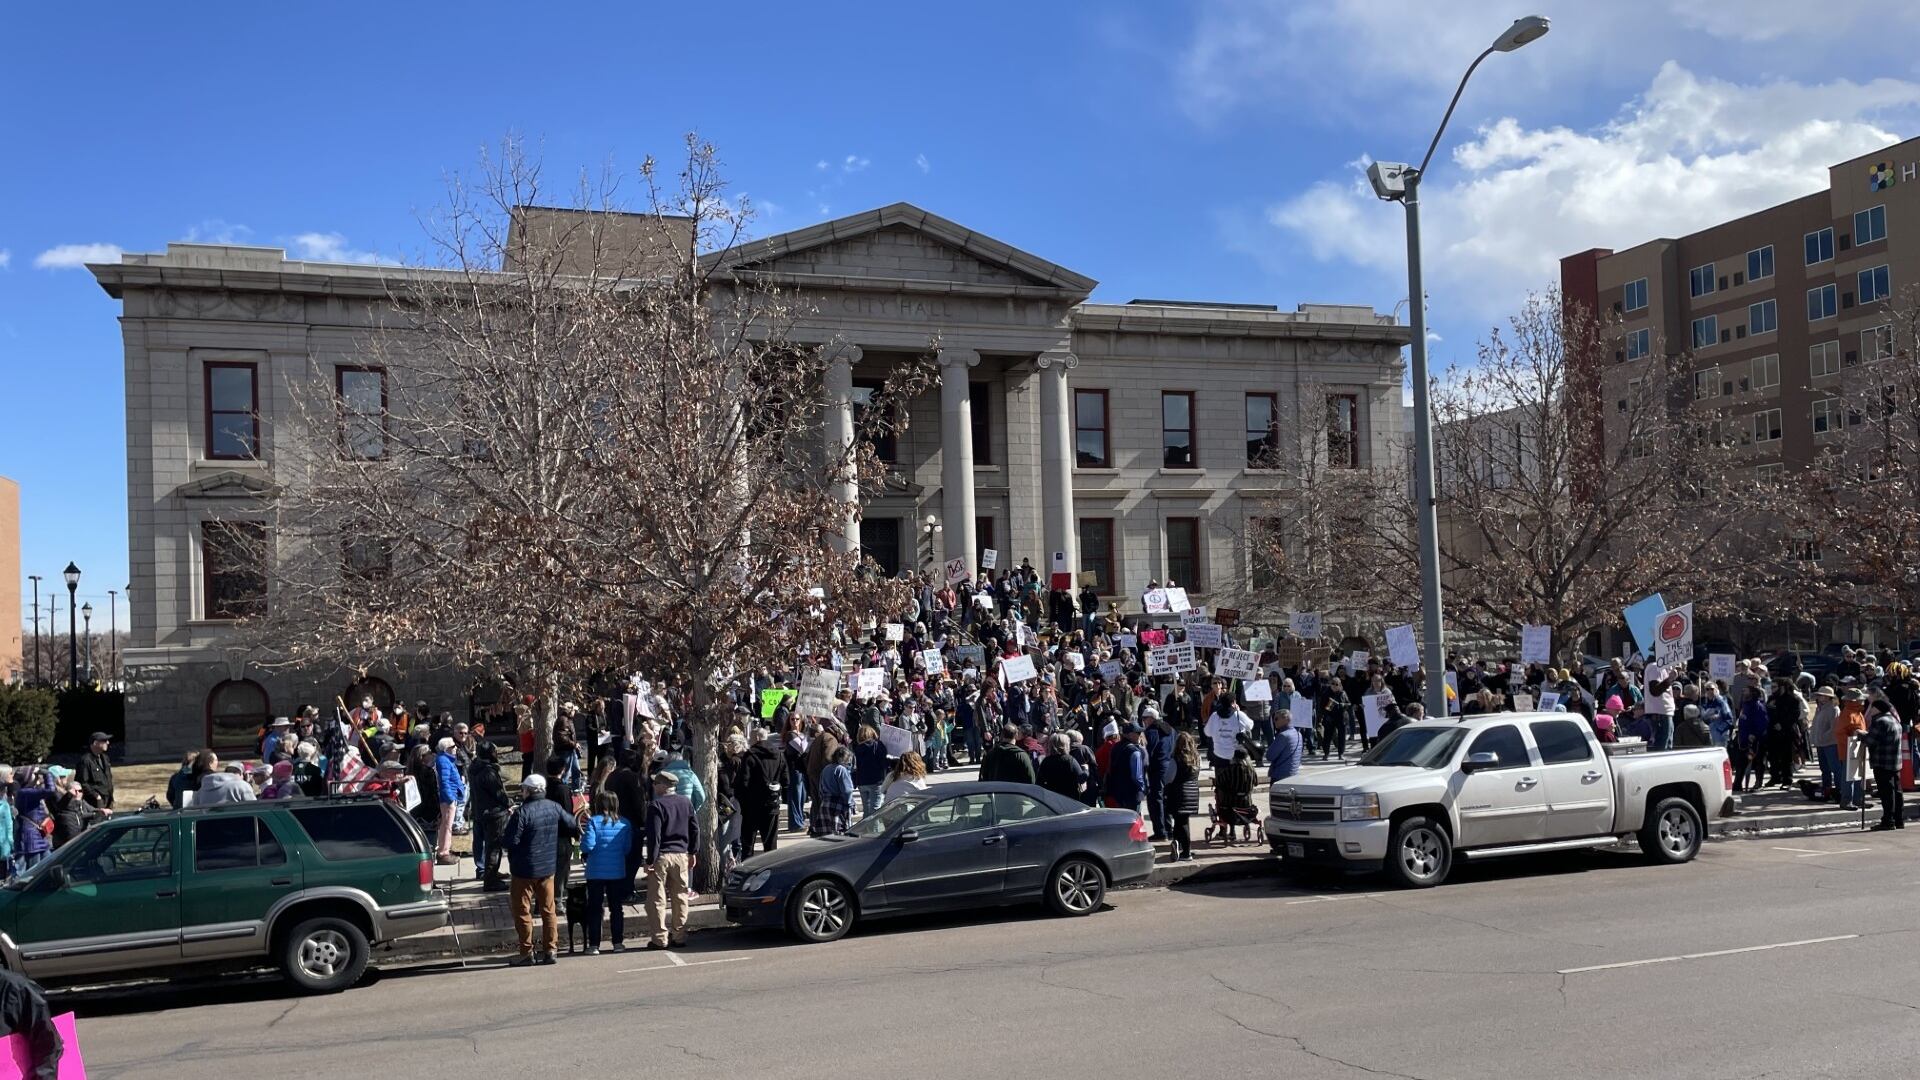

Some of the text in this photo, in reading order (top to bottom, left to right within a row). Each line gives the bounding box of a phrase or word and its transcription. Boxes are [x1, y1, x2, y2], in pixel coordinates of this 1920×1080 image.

[842, 296, 952, 317] CITY HALL
[1187, 607, 1201, 616] NO
[1666, 640, 1683, 652] THE
[1228, 651, 1250, 661] REJECT
